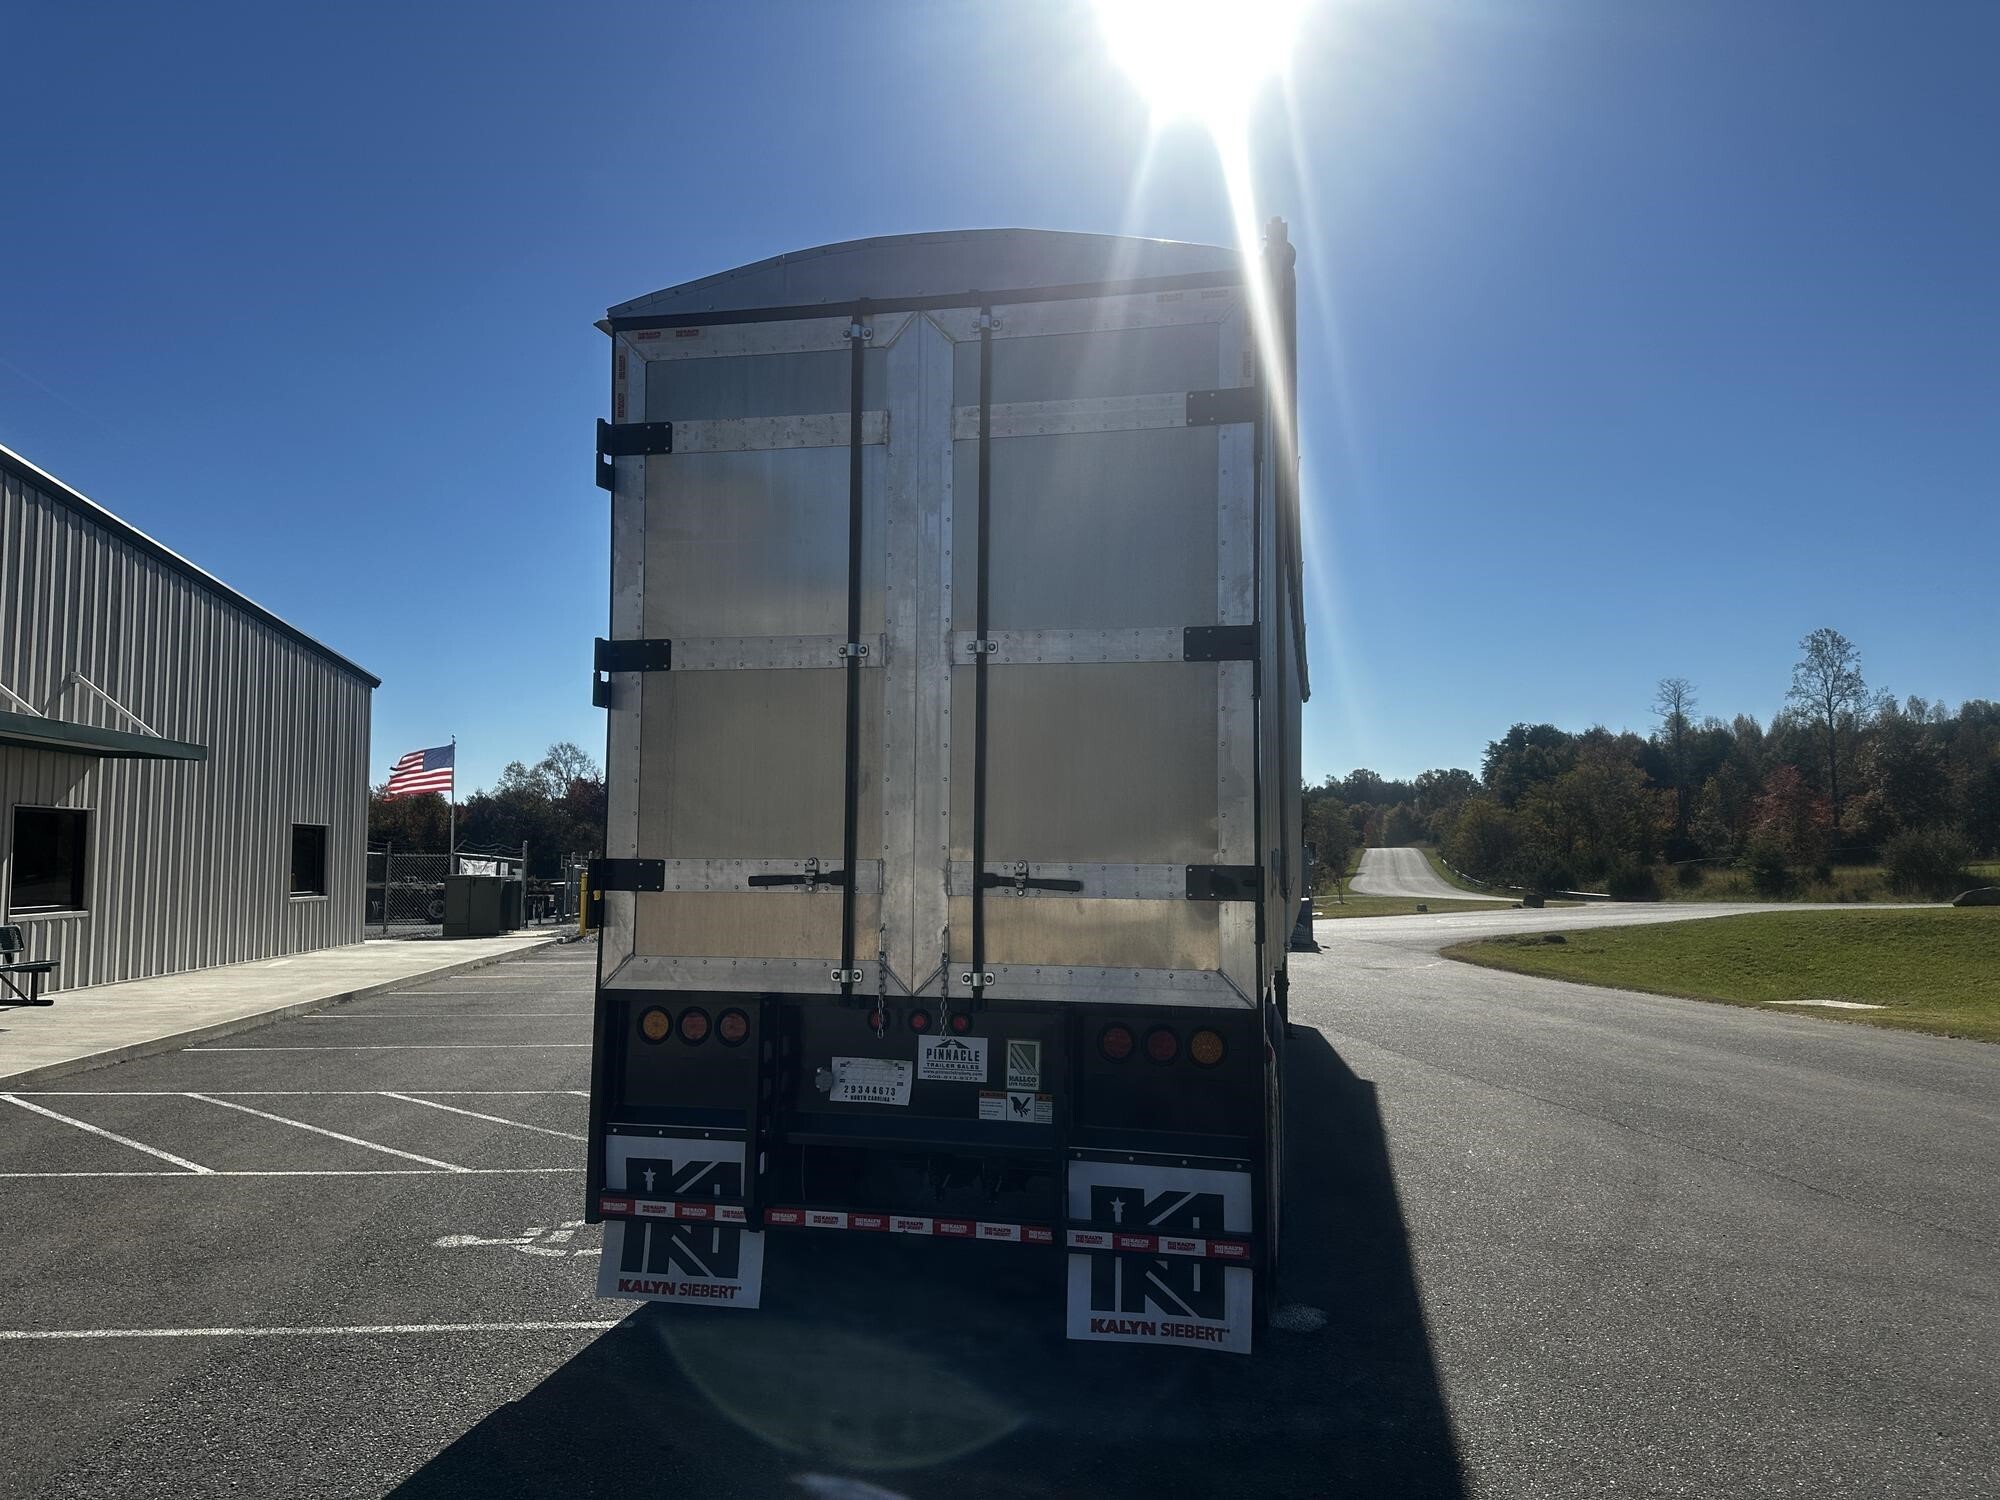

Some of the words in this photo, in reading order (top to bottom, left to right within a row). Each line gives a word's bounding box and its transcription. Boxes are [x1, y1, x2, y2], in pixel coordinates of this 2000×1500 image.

[926, 1048, 980, 1062] PINNACLE
[1008, 1075, 1037, 1083] HALLCO
[844, 1085, 896, 1097] 29344673
[618, 1279, 676, 1296] KALYN
[678, 1283, 737, 1299] SIEBERT
[1090, 1318, 1157, 1336] KALYN
[1160, 1322, 1226, 1342] SIEBERT
